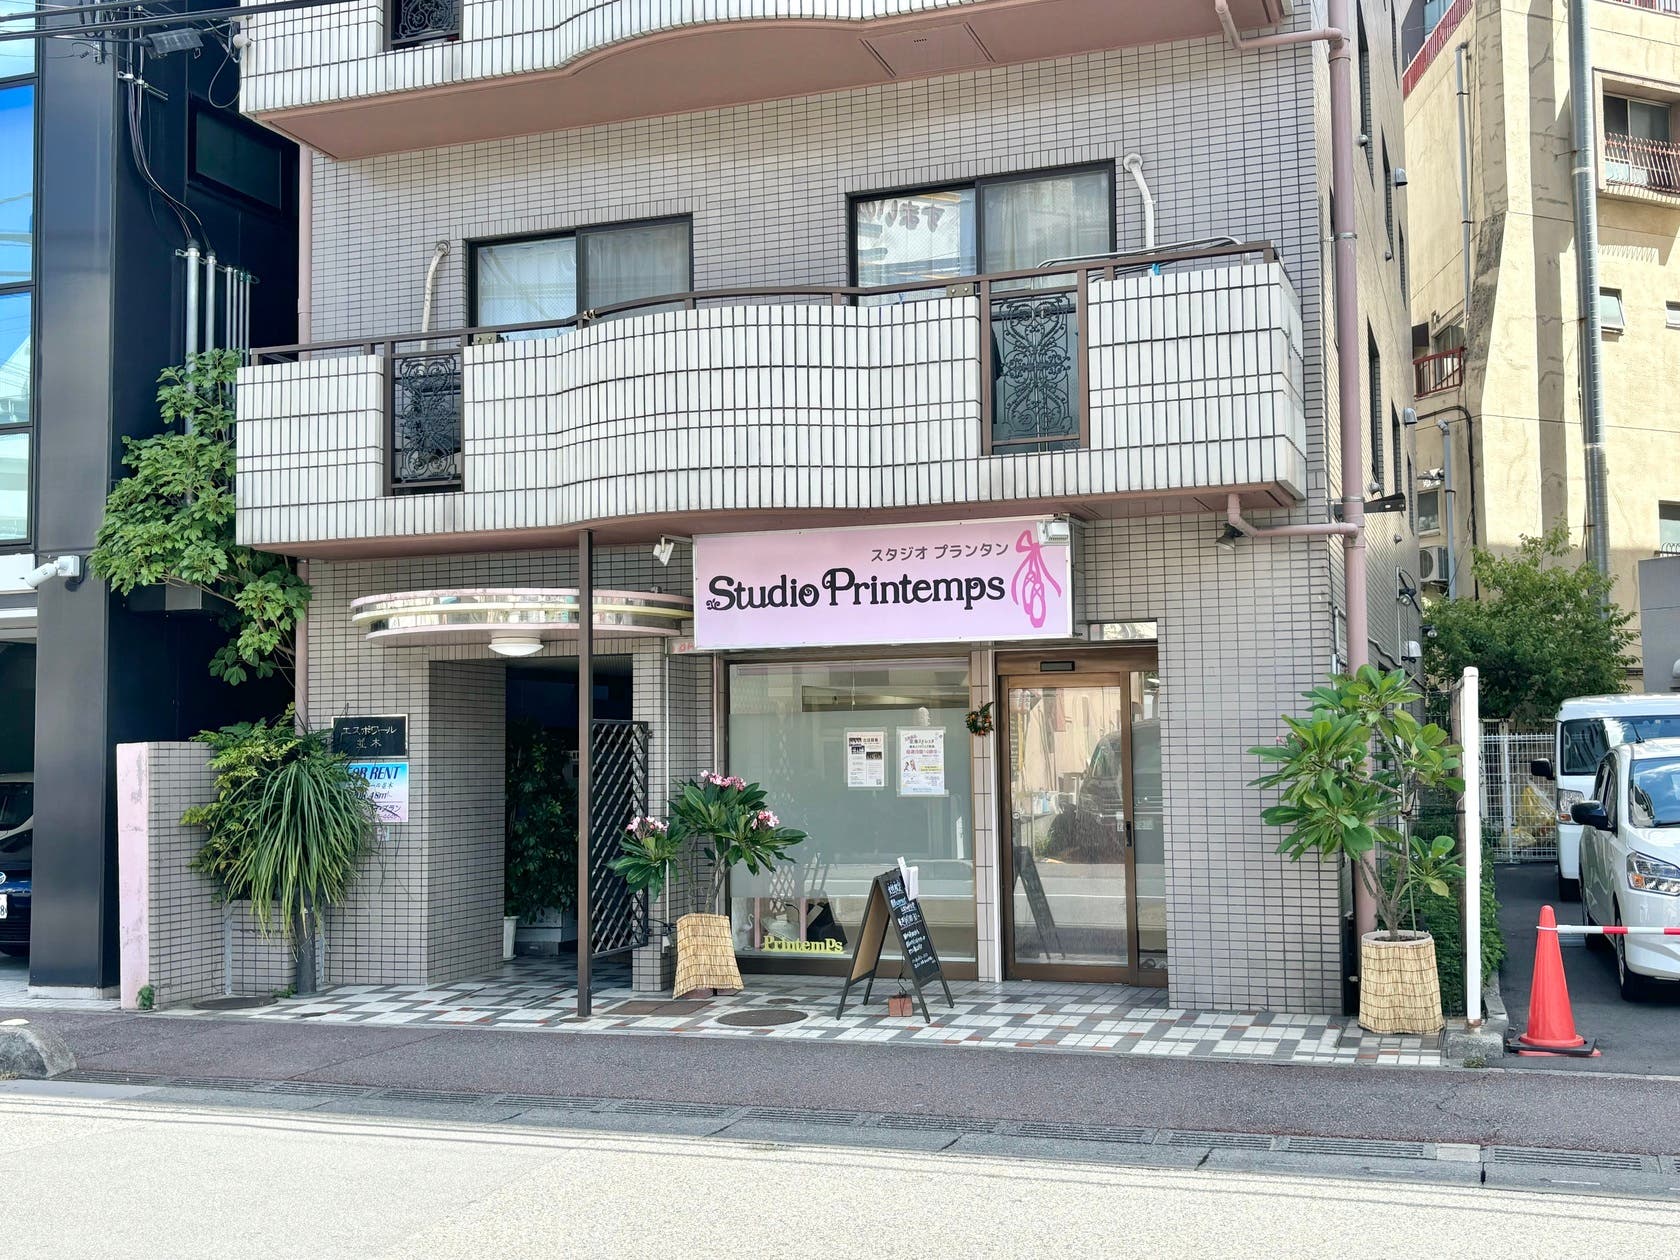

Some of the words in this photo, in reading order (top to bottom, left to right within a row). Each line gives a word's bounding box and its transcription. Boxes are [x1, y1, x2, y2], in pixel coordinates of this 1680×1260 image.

[871, 545, 928, 562] スタジオ
[935, 542, 1009, 559] プランタン
[706, 574, 820, 611] Studio
[822, 567, 1006, 611] Printemps
[370, 766, 400, 780] RENT
